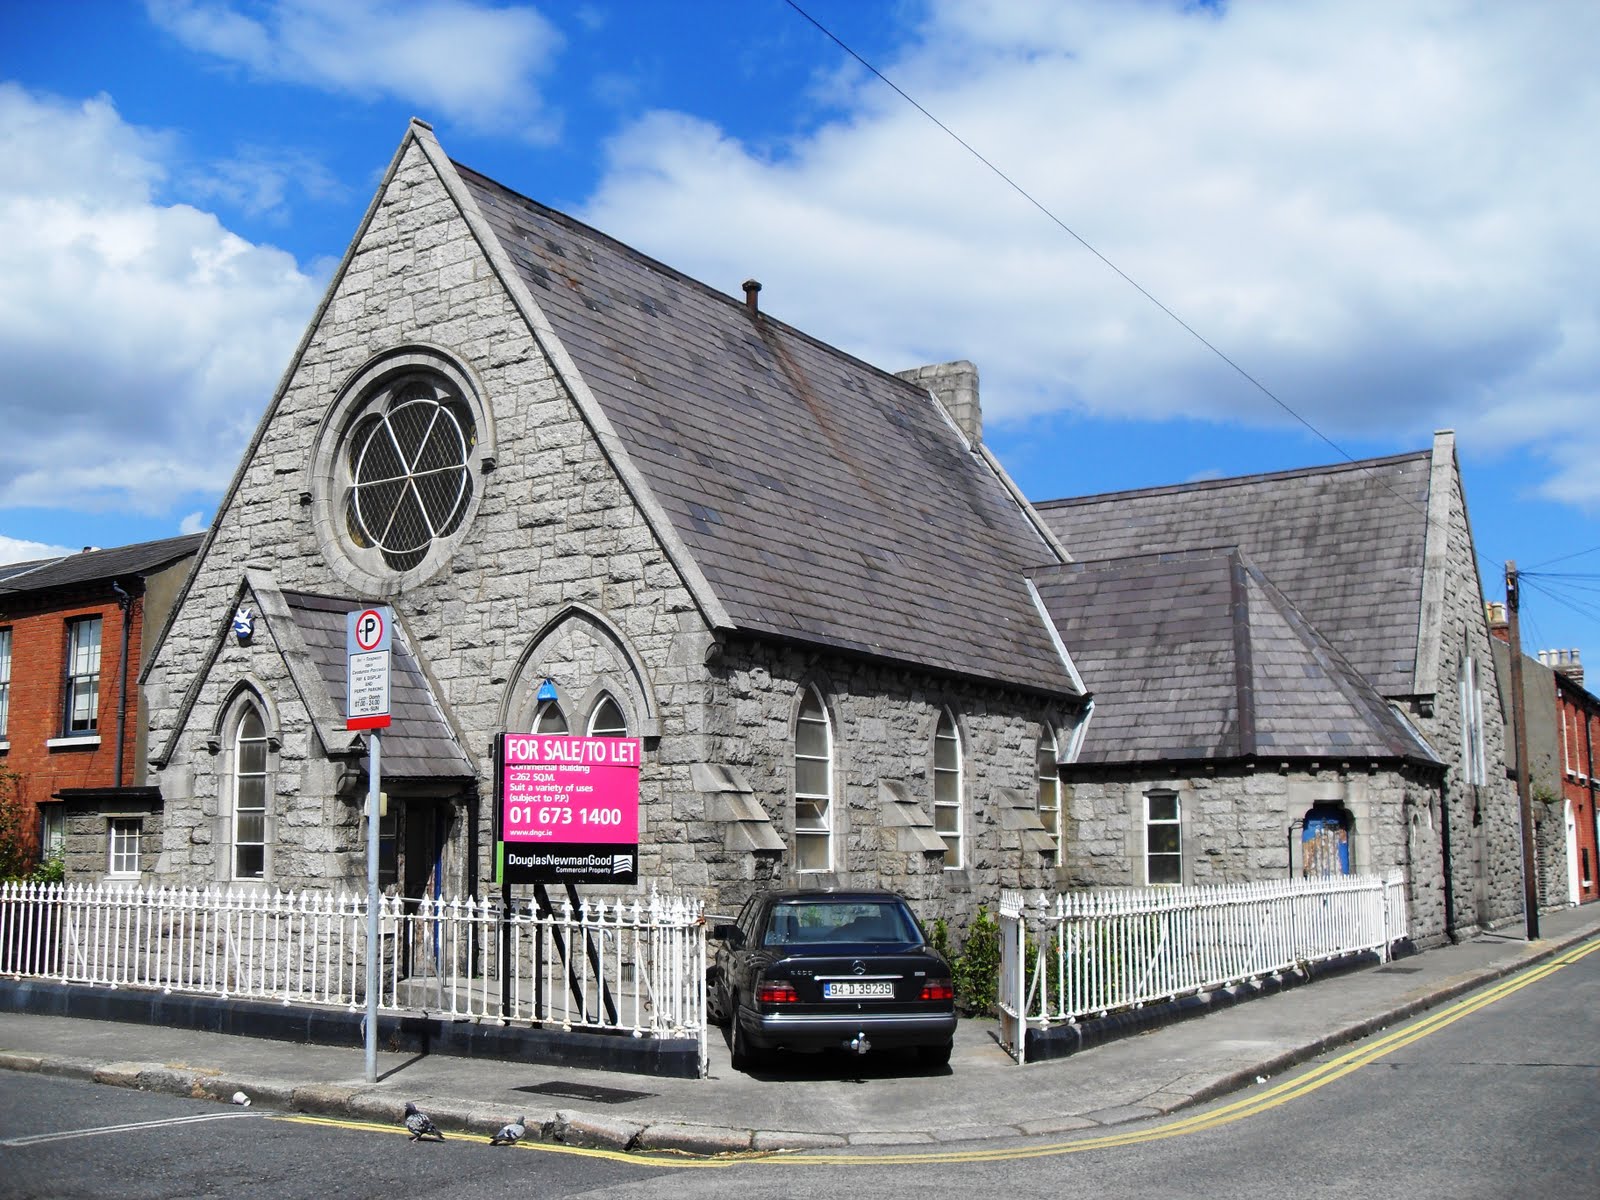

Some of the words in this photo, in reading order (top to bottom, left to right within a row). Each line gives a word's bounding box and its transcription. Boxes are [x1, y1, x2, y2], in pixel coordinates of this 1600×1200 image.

[365, 618, 376, 642] P
[508, 739, 539, 761] FOR
[544, 740, 606, 763] SALE/TO
[611, 742, 637, 762] LET
[510, 773, 530, 781] c.262
[510, 783, 526, 791] Suit
[536, 784, 564, 793] variety
[566, 784, 574, 792] of
[510, 794, 540, 804] (subject
[510, 806, 532, 824] 01
[539, 808, 572, 824] 673
[580, 808, 622, 825] 1400
[510, 829, 552, 837] www.dngc.ie
[508, 854, 612, 868] DouglasNewmanGood
